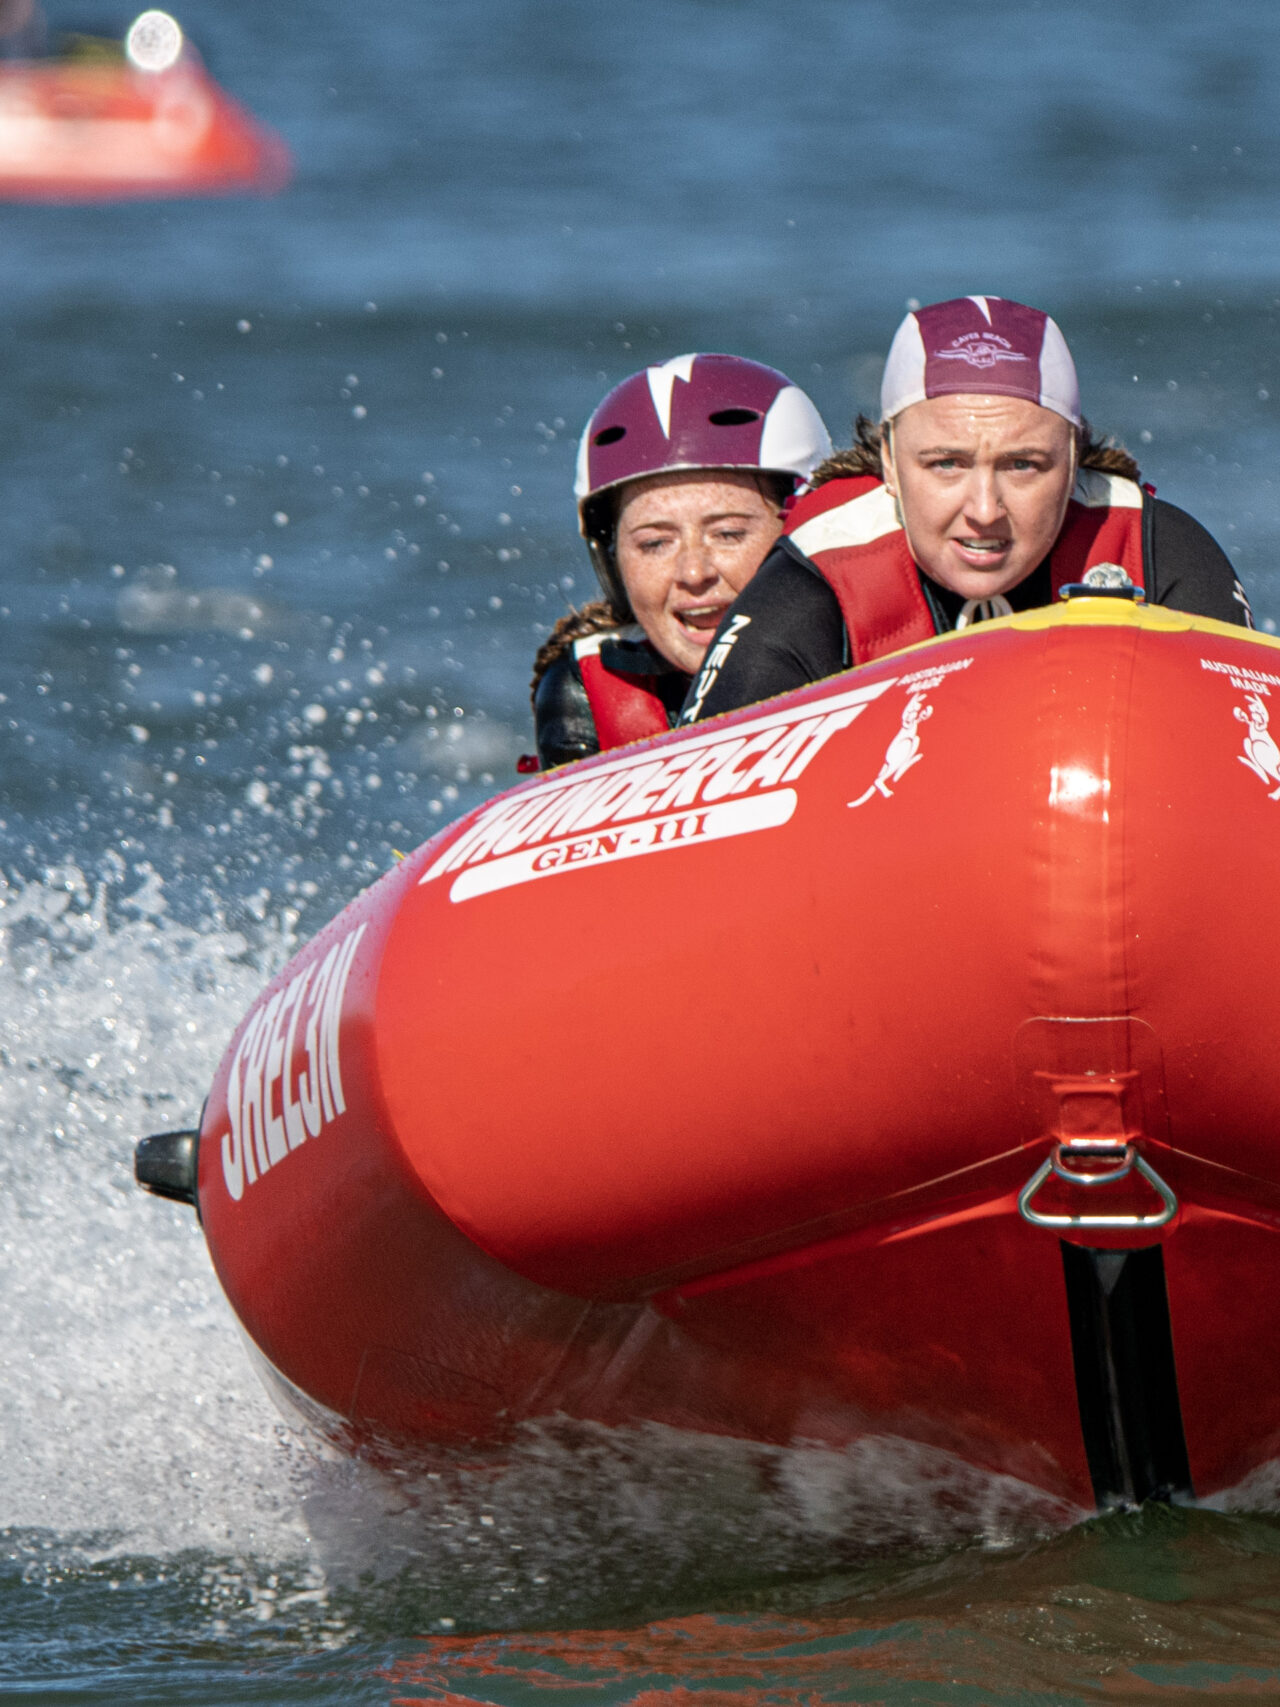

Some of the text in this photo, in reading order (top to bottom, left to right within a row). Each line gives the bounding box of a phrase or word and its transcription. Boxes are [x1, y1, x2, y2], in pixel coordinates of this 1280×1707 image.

[1230, 676, 1271, 696] MADE
[418, 677, 898, 885] THUNDERCAT
[531, 814, 710, 872] GEN-III
